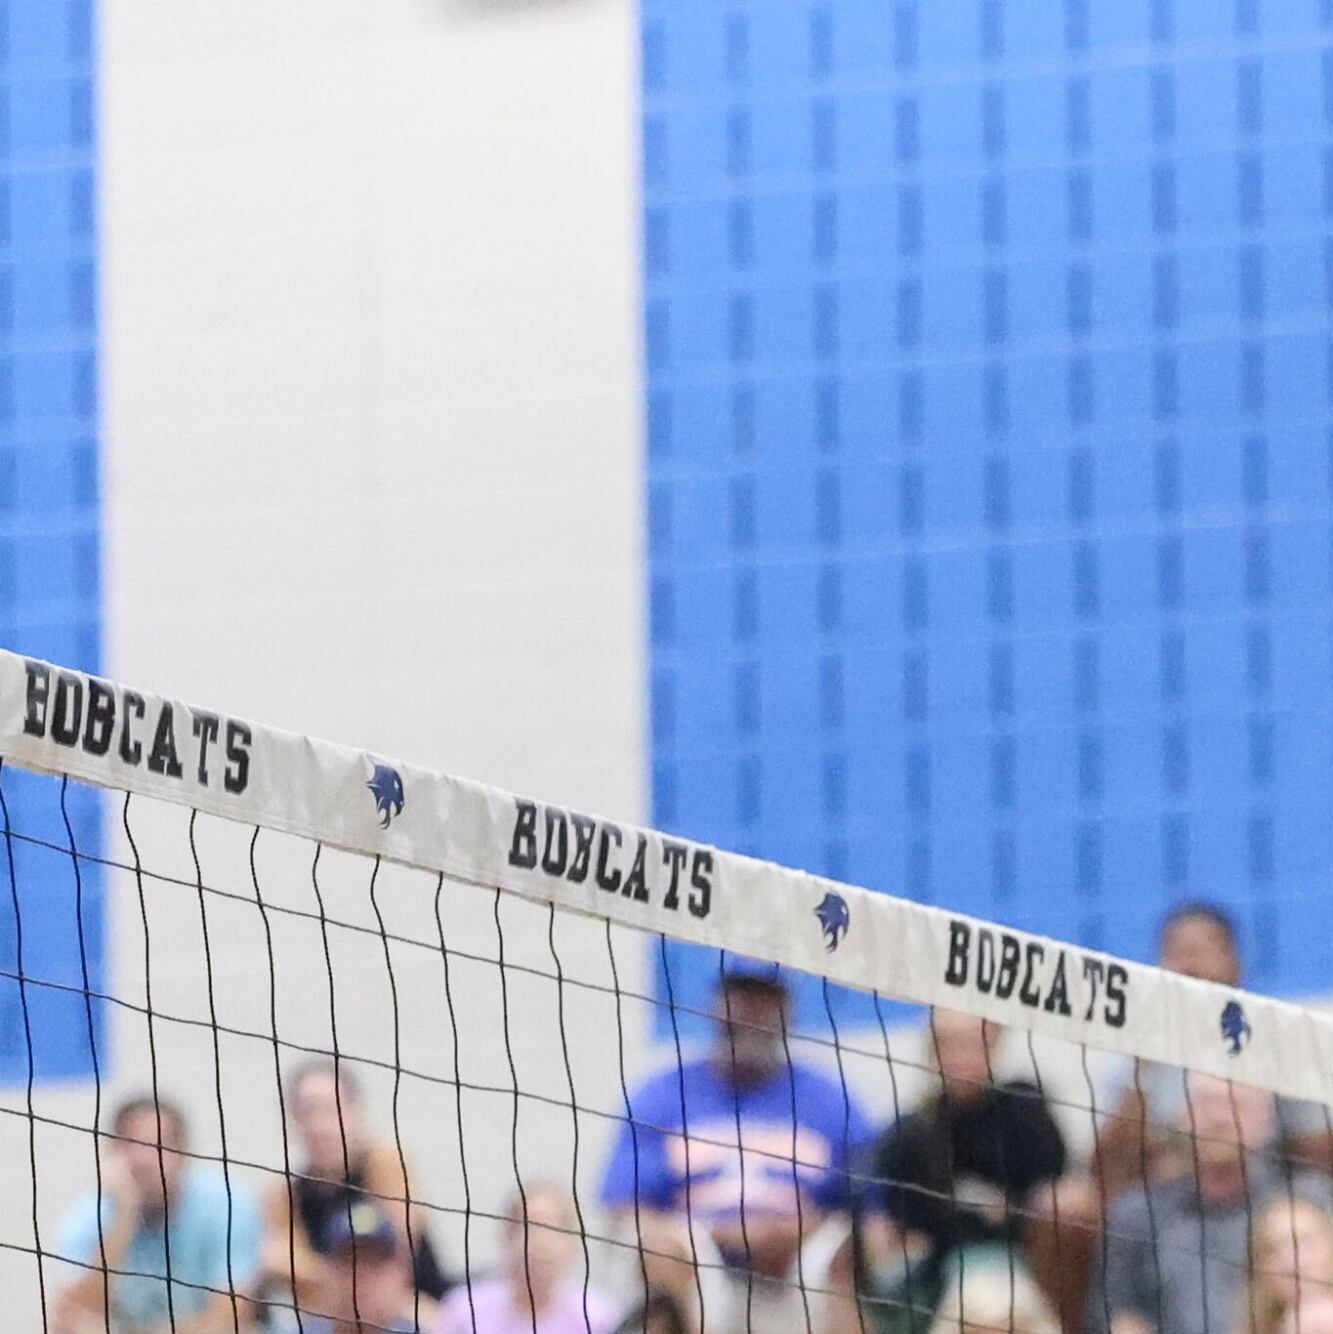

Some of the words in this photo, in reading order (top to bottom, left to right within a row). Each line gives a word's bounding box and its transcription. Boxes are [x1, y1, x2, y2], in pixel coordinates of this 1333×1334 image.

[24, 660, 253, 796] BOBCATS
[508, 798, 715, 920] BOBCATS
[944, 920, 1129, 1029] BOBCATS
